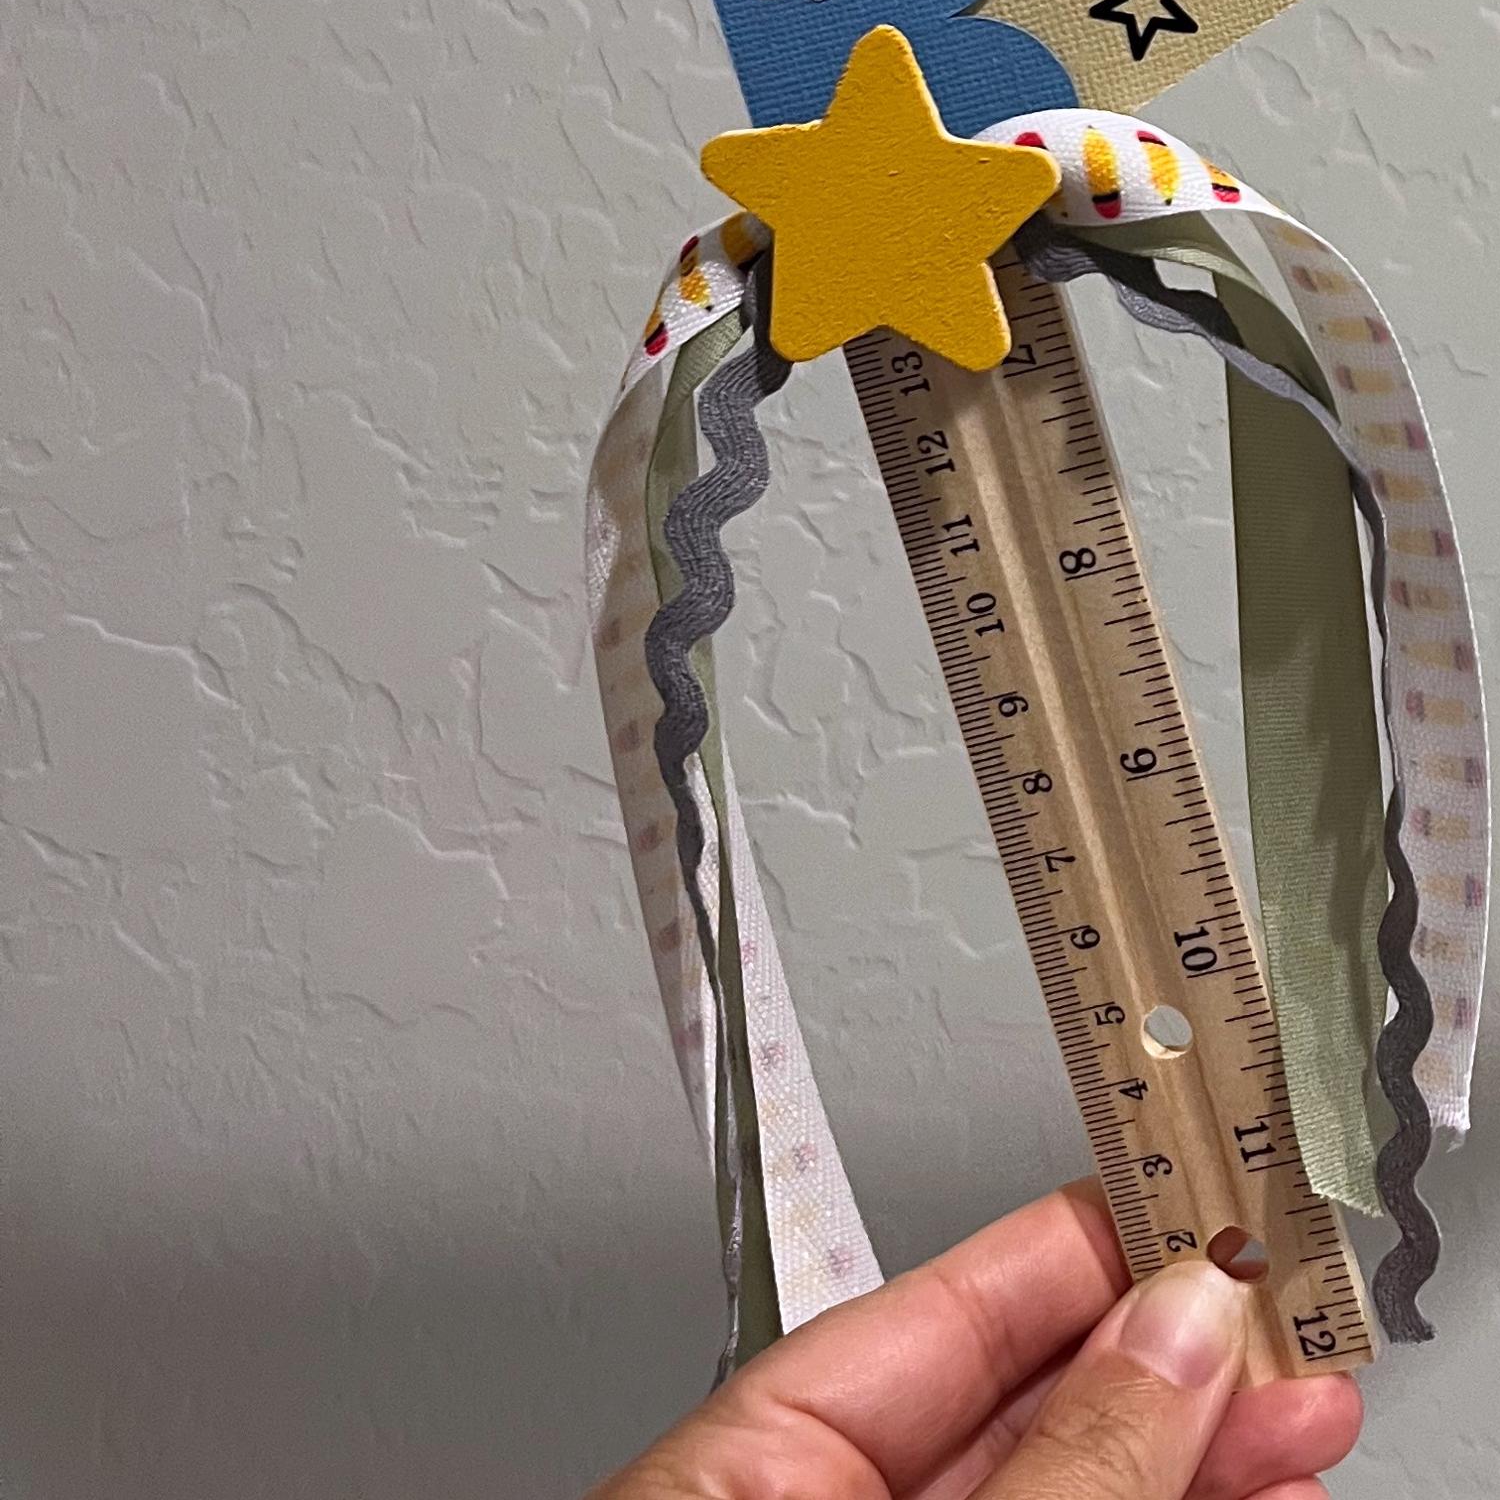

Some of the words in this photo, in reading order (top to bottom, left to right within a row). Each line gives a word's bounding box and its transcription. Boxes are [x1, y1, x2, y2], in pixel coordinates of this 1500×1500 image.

[1002, 343, 1037, 366] 7
[891, 351, 930, 396] 13
[917, 430, 955, 475] 12
[943, 514, 980, 557] 11
[1059, 547, 1096, 574] 8
[966, 592, 1004, 637] 10
[998, 695, 1029, 718] 9
[1120, 747, 1158, 774] 9
[1022, 772, 1053, 795] 8
[1045, 853, 1076, 873] 7
[1070, 928, 1100, 950] 6
[1174, 925, 1218, 972] 10
[1095, 1006, 1126, 1027] 5
[1119, 1079, 1148, 1101] 4
[1233, 1121, 1277, 1164] 11
[1143, 1156, 1173, 1178] 3
[1166, 1231, 1197, 1252] 2
[1293, 1310, 1336, 1357] 12
